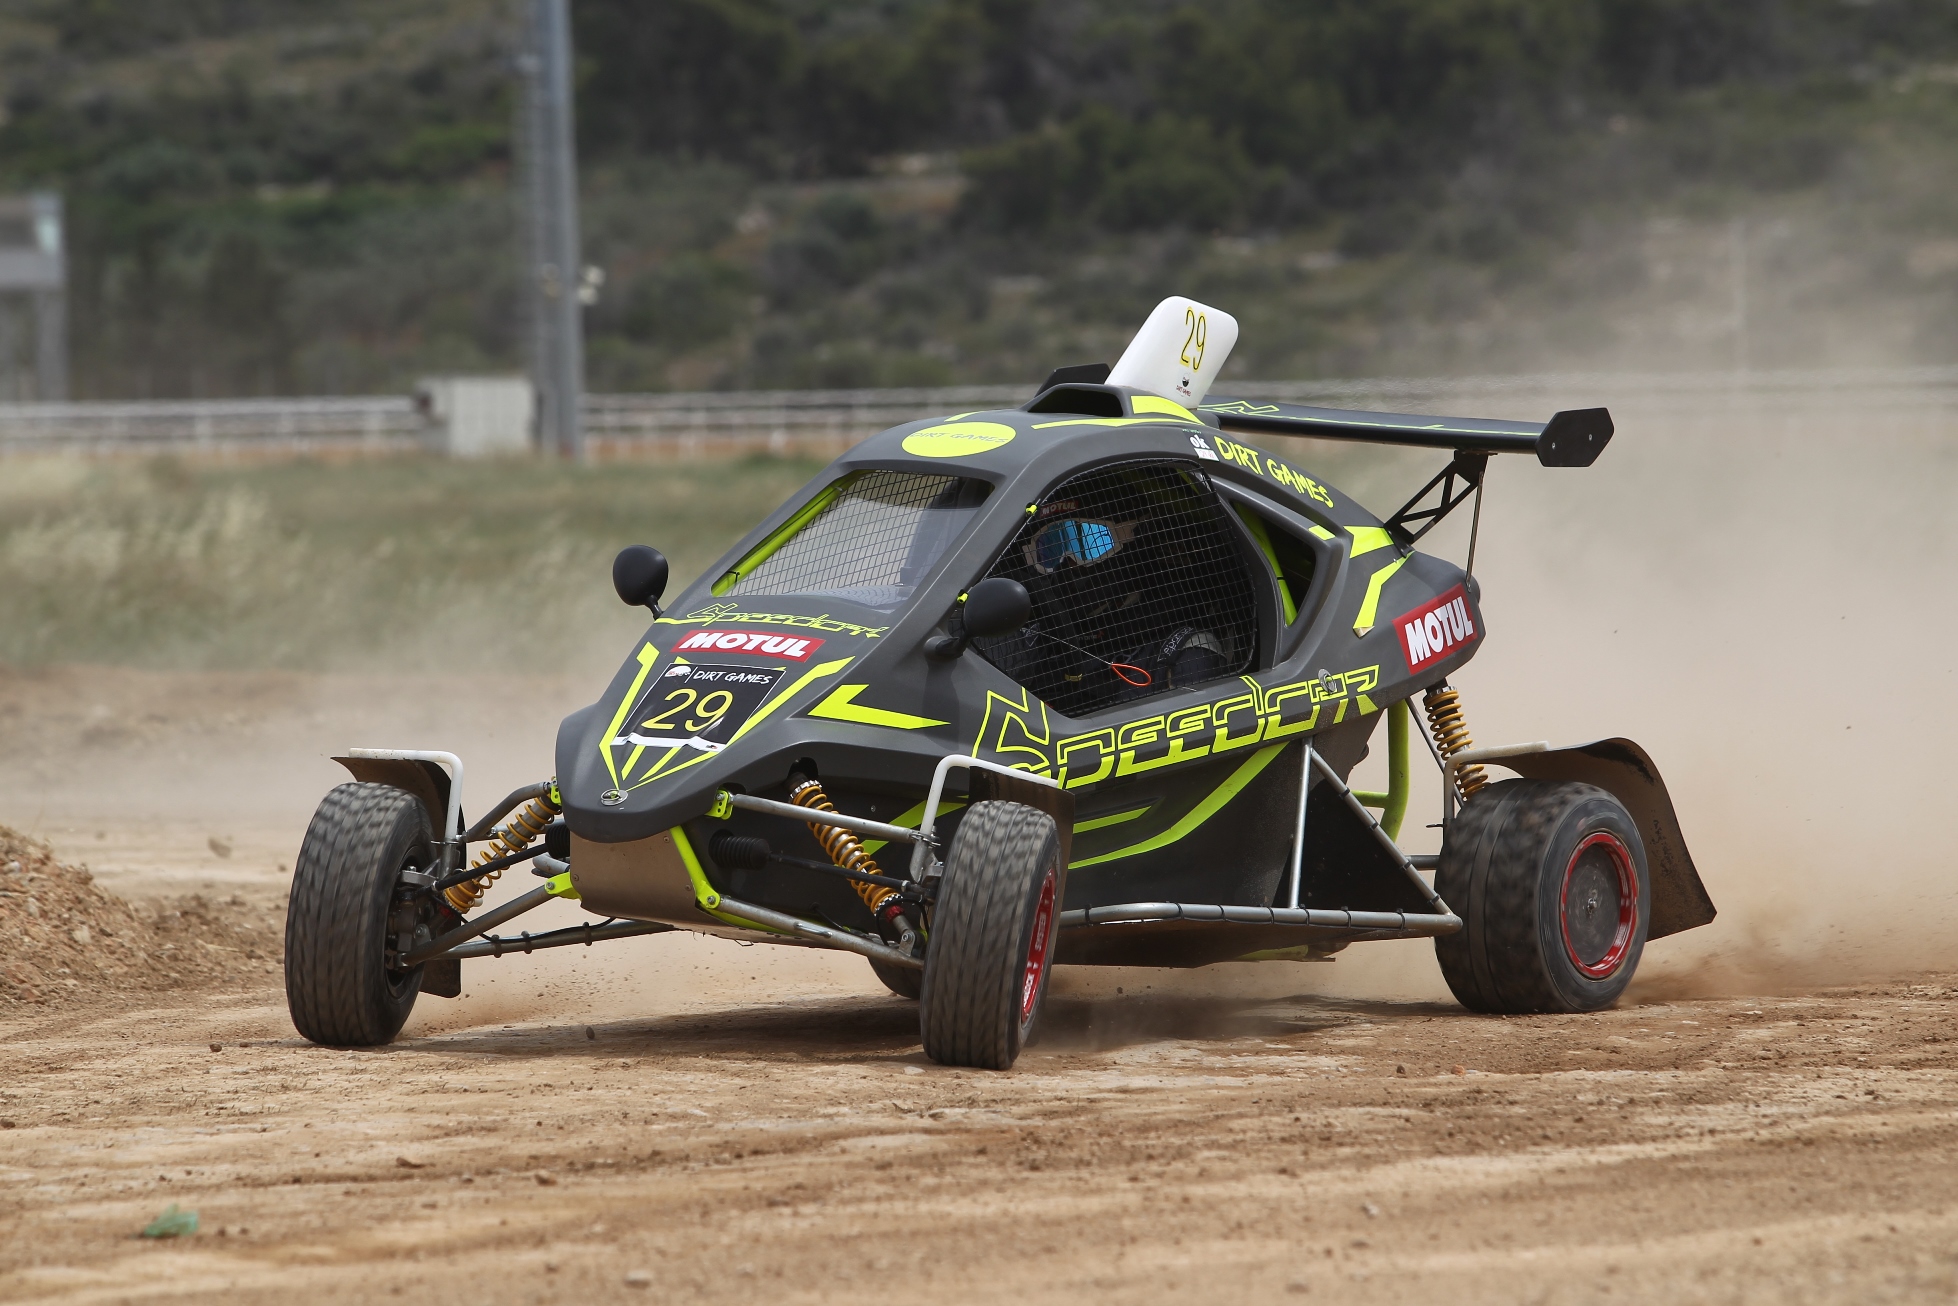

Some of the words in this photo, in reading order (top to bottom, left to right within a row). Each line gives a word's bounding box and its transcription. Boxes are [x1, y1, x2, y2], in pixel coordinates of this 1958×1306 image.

[1180, 306, 1207, 373] 29
[950, 433, 1009, 443] GAMES
[1213, 435, 1264, 476] DIRT
[1266, 458, 1334, 508] GAMES
[1041, 501, 1077, 516] MOTUL
[678, 632, 811, 658] MOTUL
[1404, 596, 1474, 666] MOTUL
[692, 670, 727, 682] DIRT
[724, 672, 773, 685] GAMES
[641, 687, 733, 732] 29
